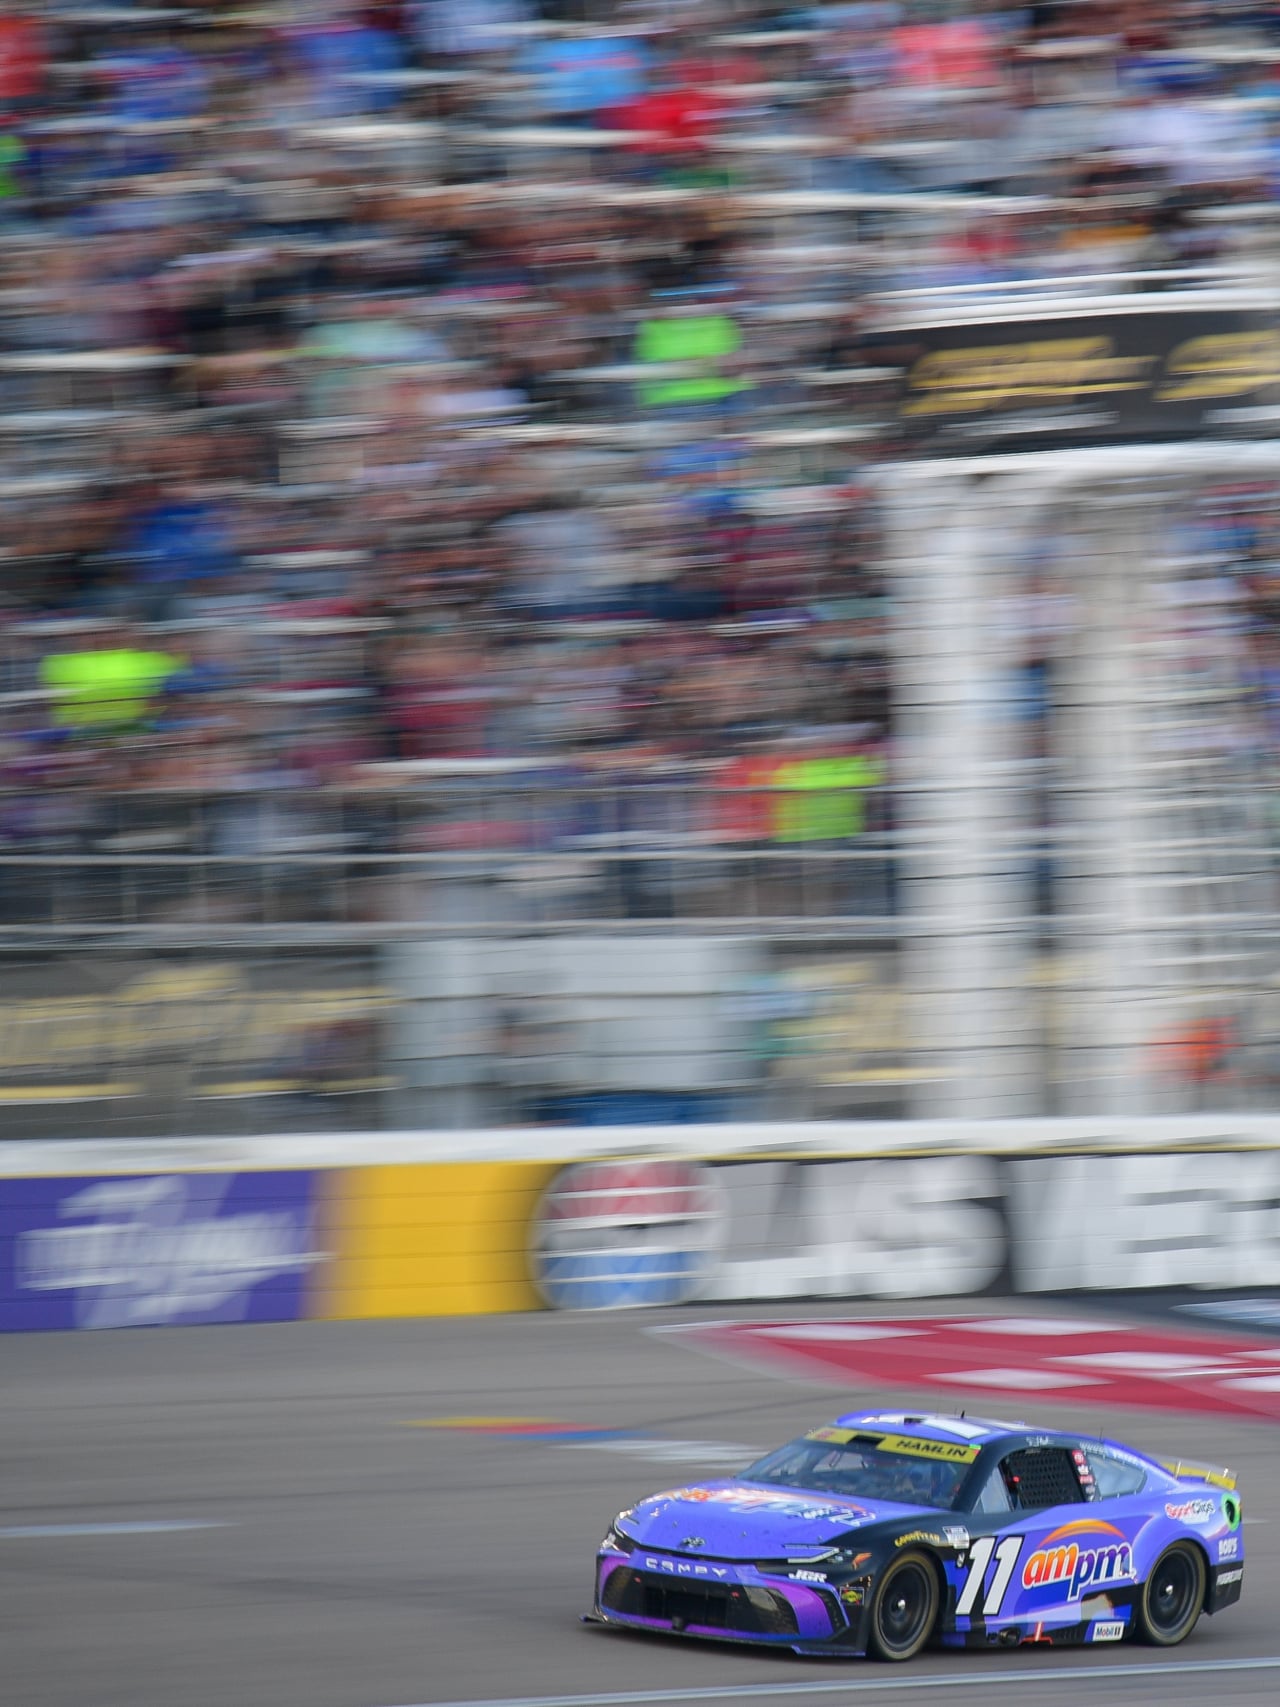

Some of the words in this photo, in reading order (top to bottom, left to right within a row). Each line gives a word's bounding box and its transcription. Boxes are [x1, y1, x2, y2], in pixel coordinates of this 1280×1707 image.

[896, 1439, 967, 1457] HAMLIN
[646, 1557, 727, 1578] CAMRY
[955, 1536, 1024, 1616] 11
[1022, 1542, 1134, 1602] ampm
